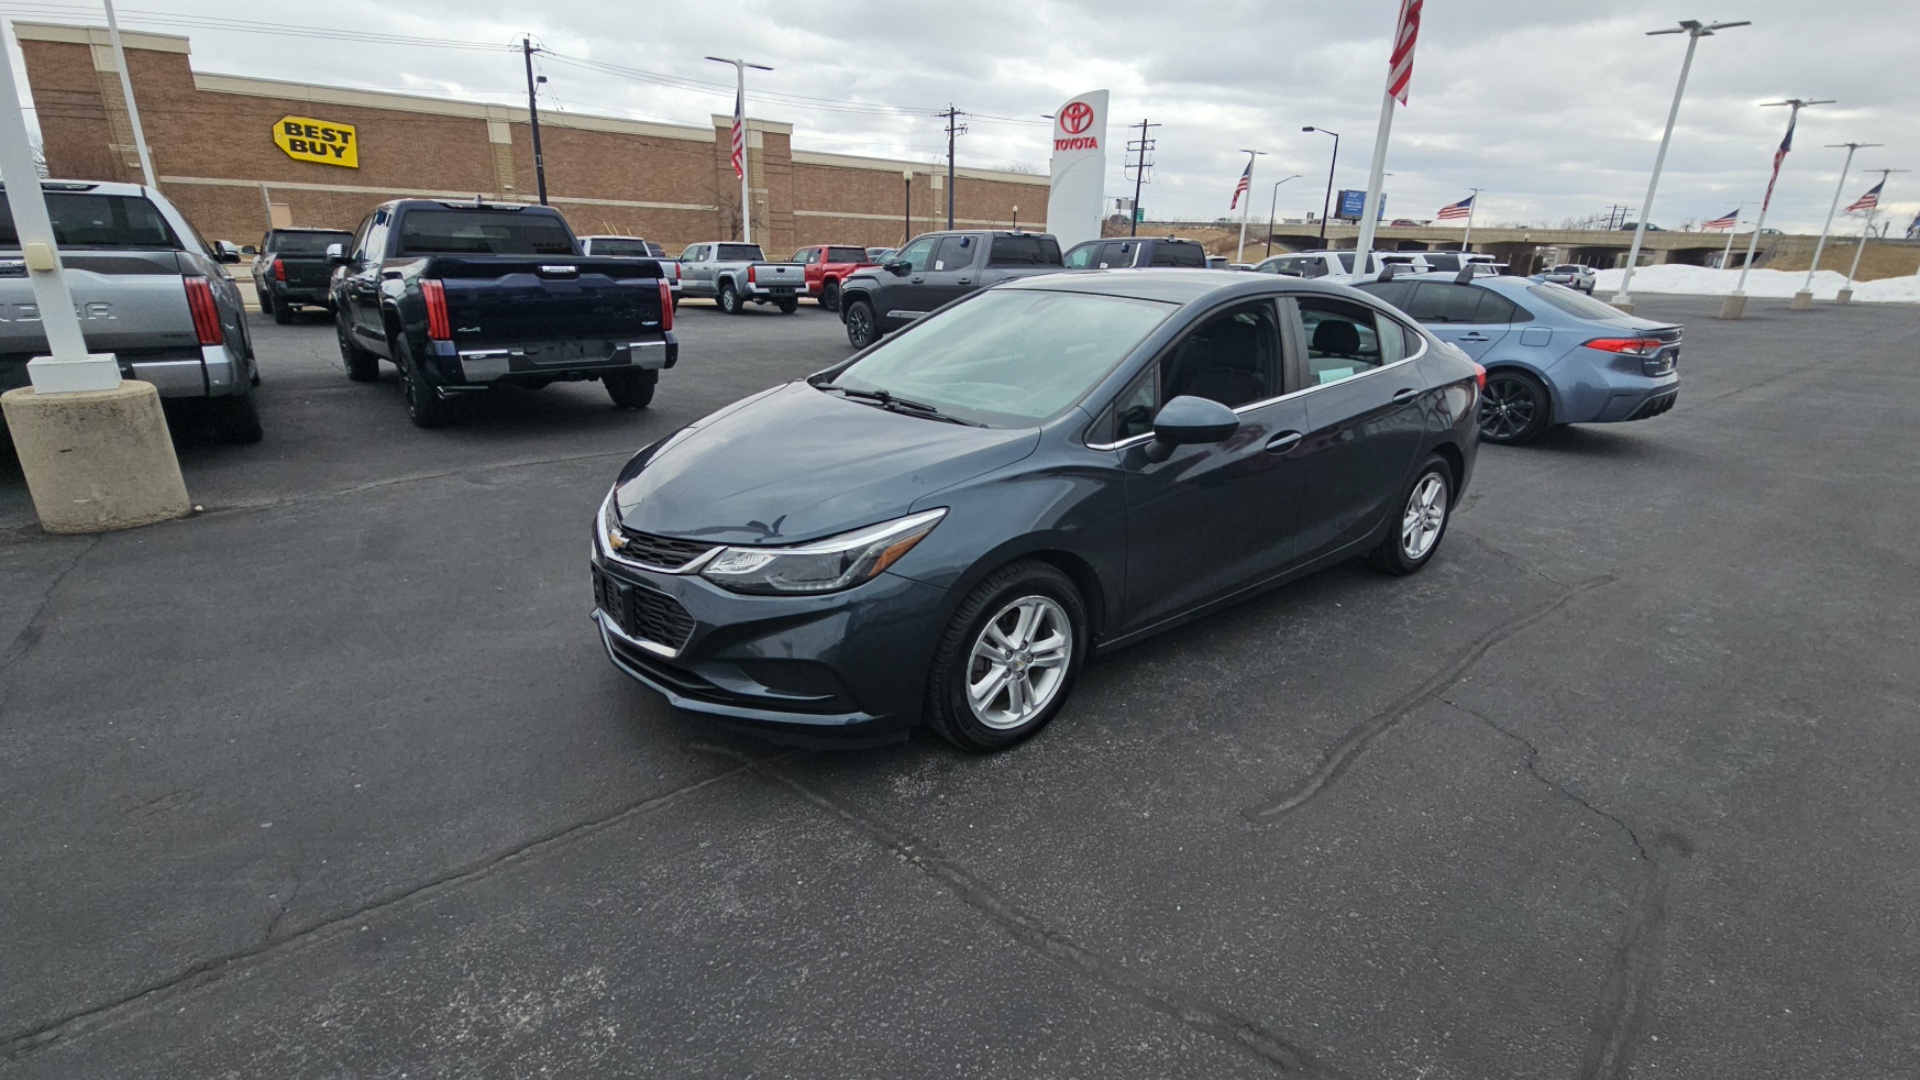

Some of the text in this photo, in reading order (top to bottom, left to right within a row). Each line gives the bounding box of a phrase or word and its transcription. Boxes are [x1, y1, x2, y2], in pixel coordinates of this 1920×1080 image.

[284, 121, 352, 144] BEST
[289, 138, 347, 159] BUY
[1054, 136, 1098, 151] TOYOTA
